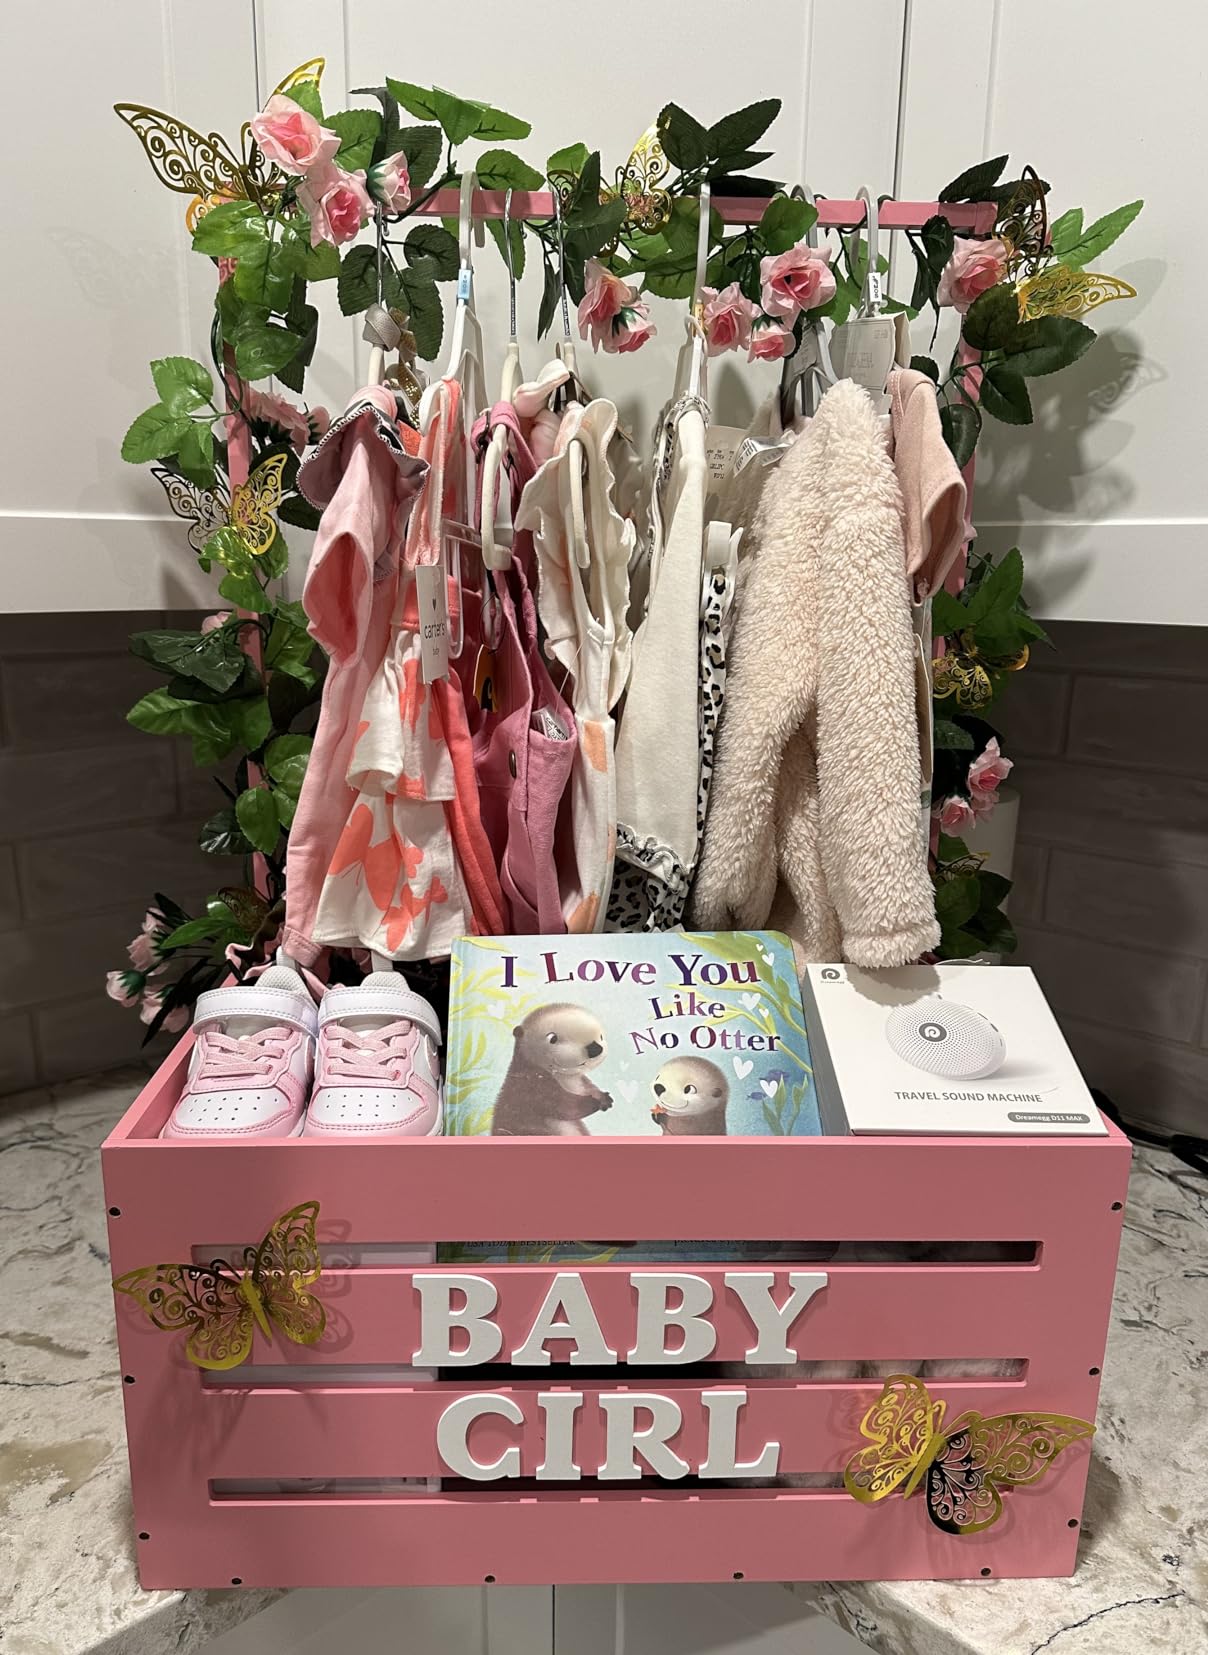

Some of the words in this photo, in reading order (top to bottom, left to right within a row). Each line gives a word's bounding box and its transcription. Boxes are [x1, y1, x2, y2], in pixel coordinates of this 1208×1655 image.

[424, 622, 446, 639] carter's
[500, 955, 519, 988] I
[540, 951, 657, 986] Love
[668, 953, 761, 986] You
[648, 992, 726, 1021] Like
[629, 1027, 679, 1055] No
[690, 1025, 781, 1052] Otter
[894, 1091, 940, 1101] TRAVEL
[942, 1092, 985, 1101] SOUND
[986, 1093, 1043, 1103] MACHINE
[1015, 1114, 1050, 1122] Dreamegg
[411, 1272, 828, 1367] BABY
[436, 1391, 780, 1481] GIRL
